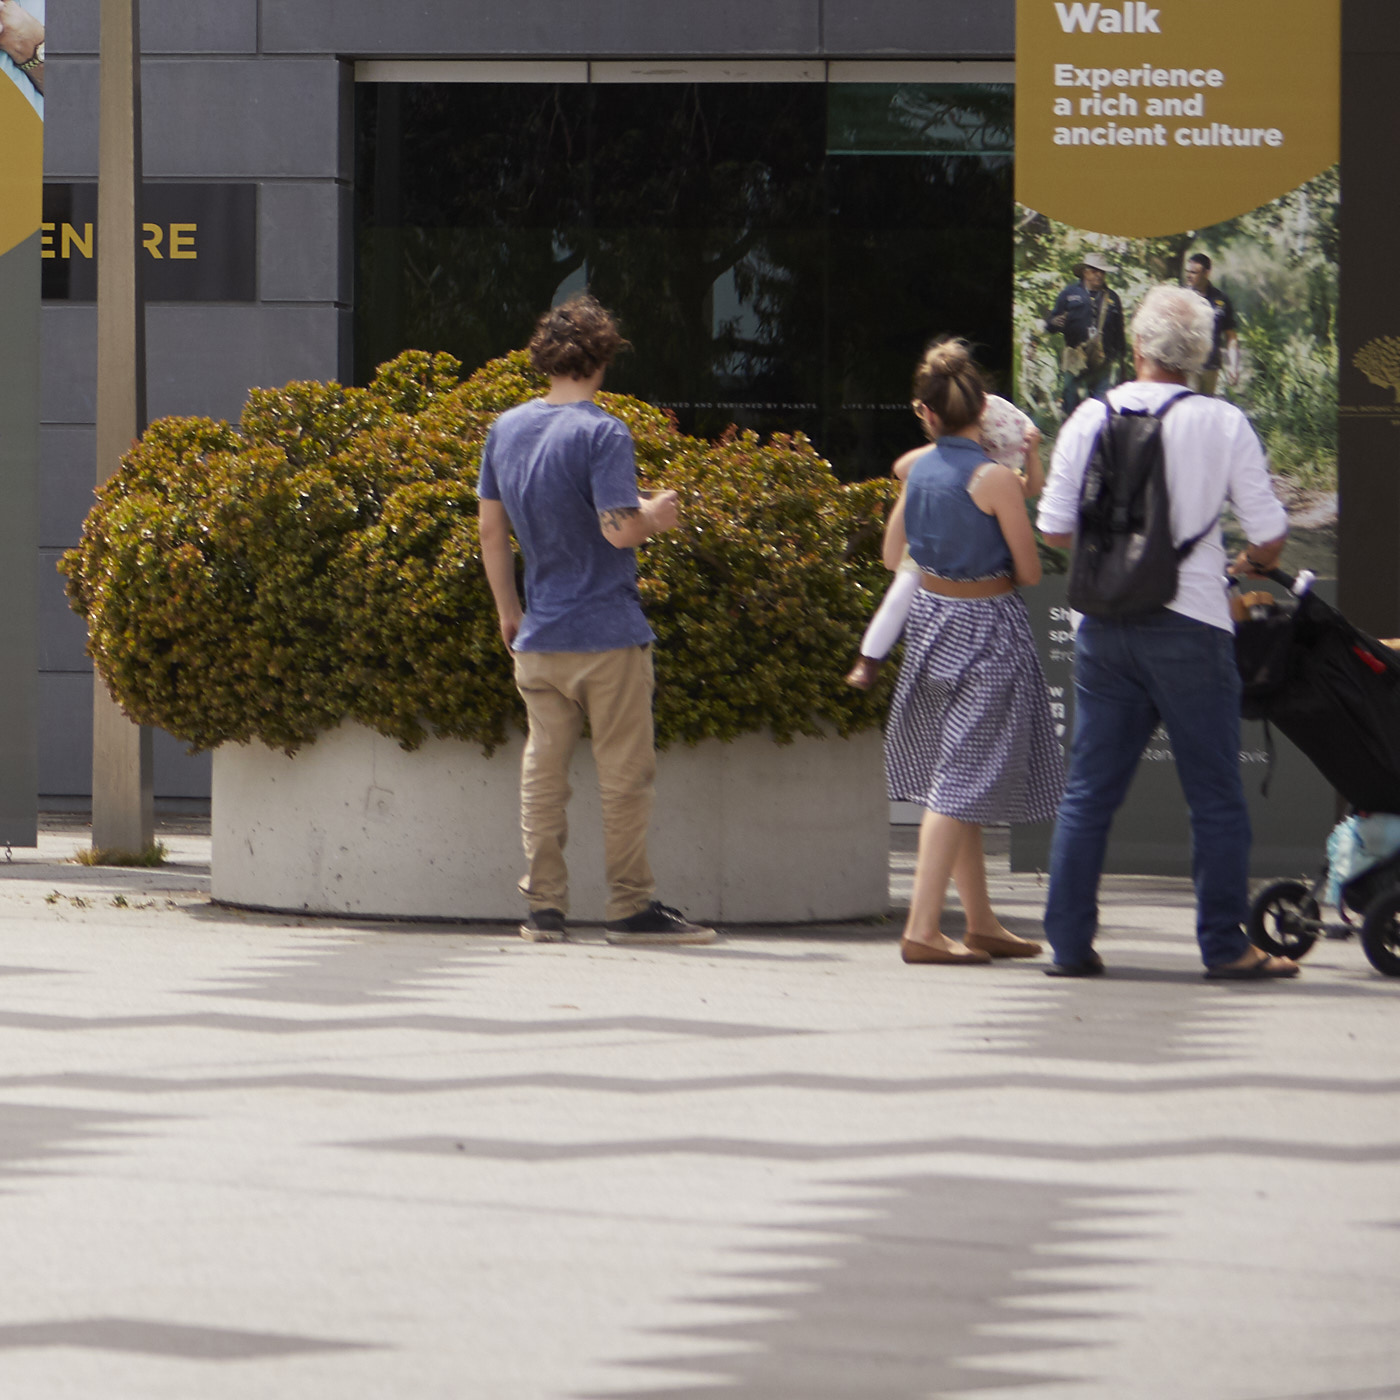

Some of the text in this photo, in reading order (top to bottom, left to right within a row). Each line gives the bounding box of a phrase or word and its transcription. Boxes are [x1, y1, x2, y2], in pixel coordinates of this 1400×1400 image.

[1053, 1, 1162, 34] Walk
[1054, 63, 1225, 92] Experience
[1053, 92, 1204, 117] a rich and
[1053, 122, 1283, 146] ancient culture
[40, 222, 198, 260] ENRE
